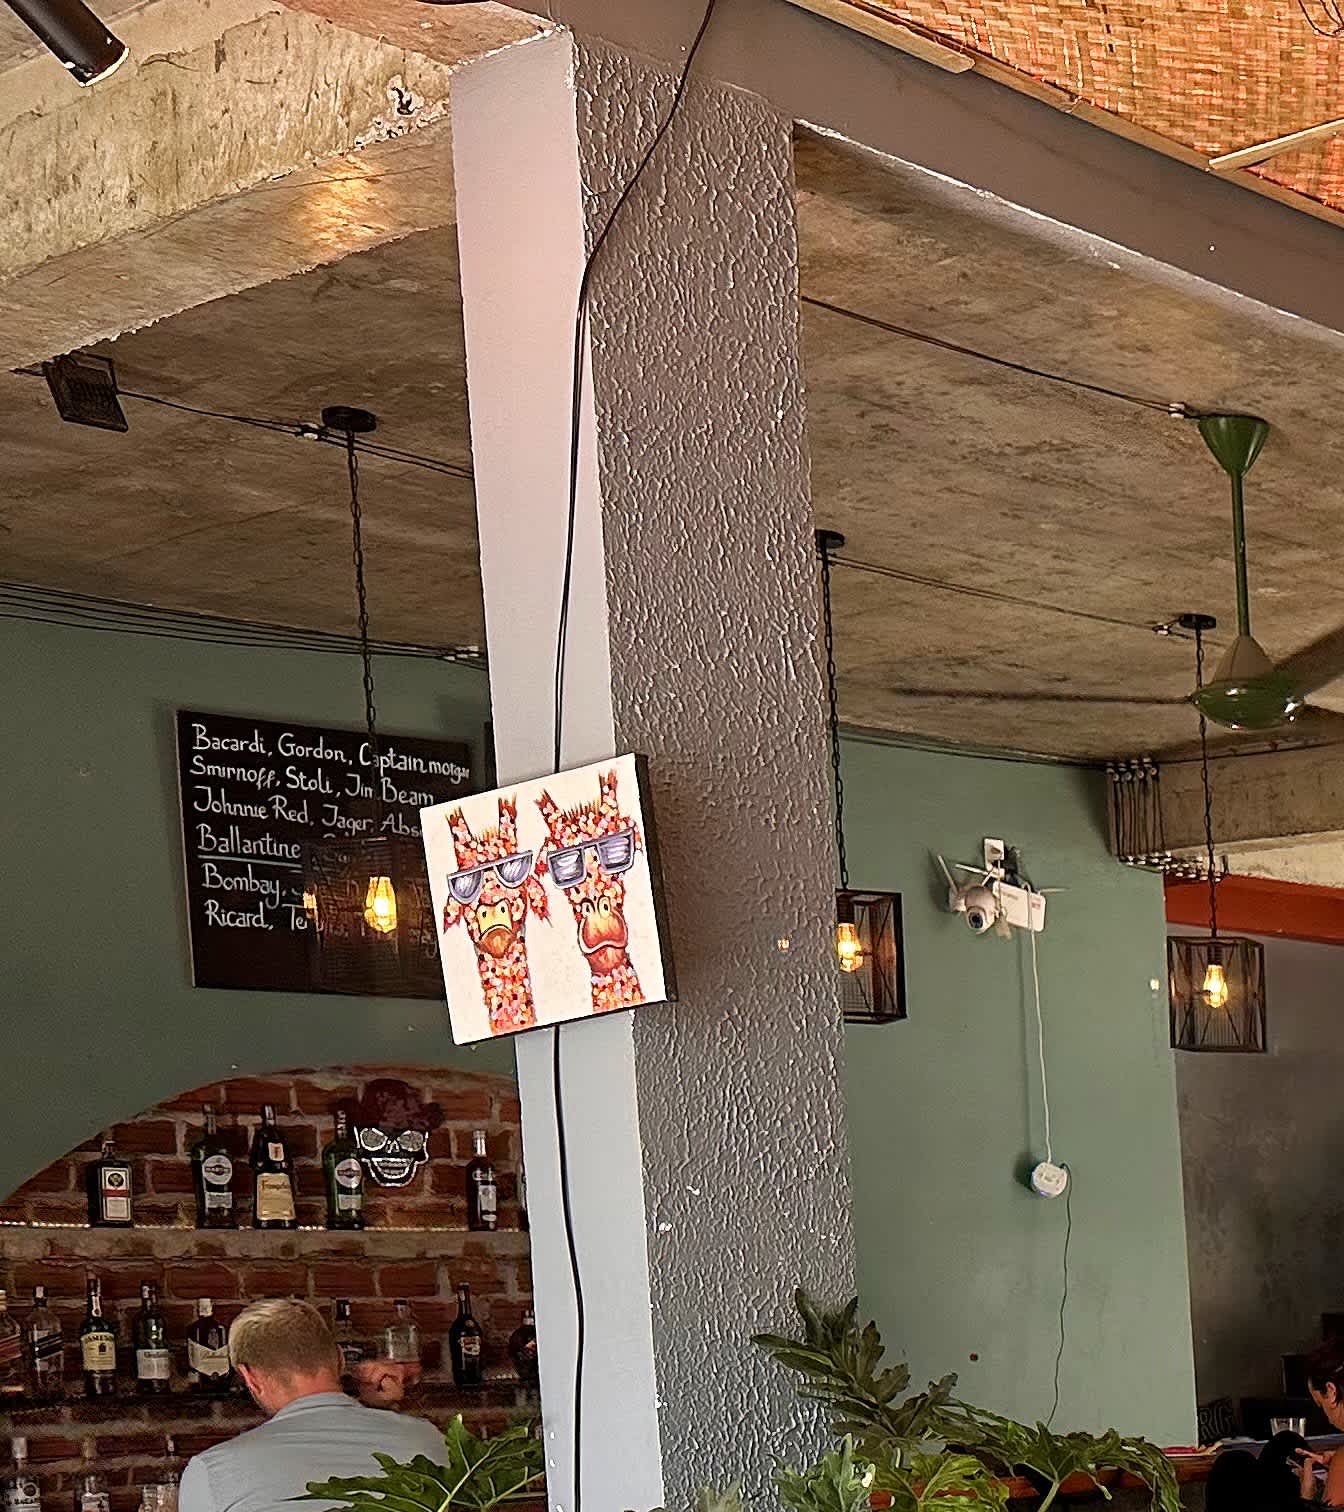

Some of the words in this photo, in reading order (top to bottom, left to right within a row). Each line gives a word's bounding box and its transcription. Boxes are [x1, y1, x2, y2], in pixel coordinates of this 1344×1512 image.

[191, 723, 273, 757] Bacardi,
[189, 754, 281, 790] Smirnoff,
[380, 776, 434, 806] Beam
[193, 785, 270, 820] Johnnie
[204, 899, 274, 931] Ricard,
